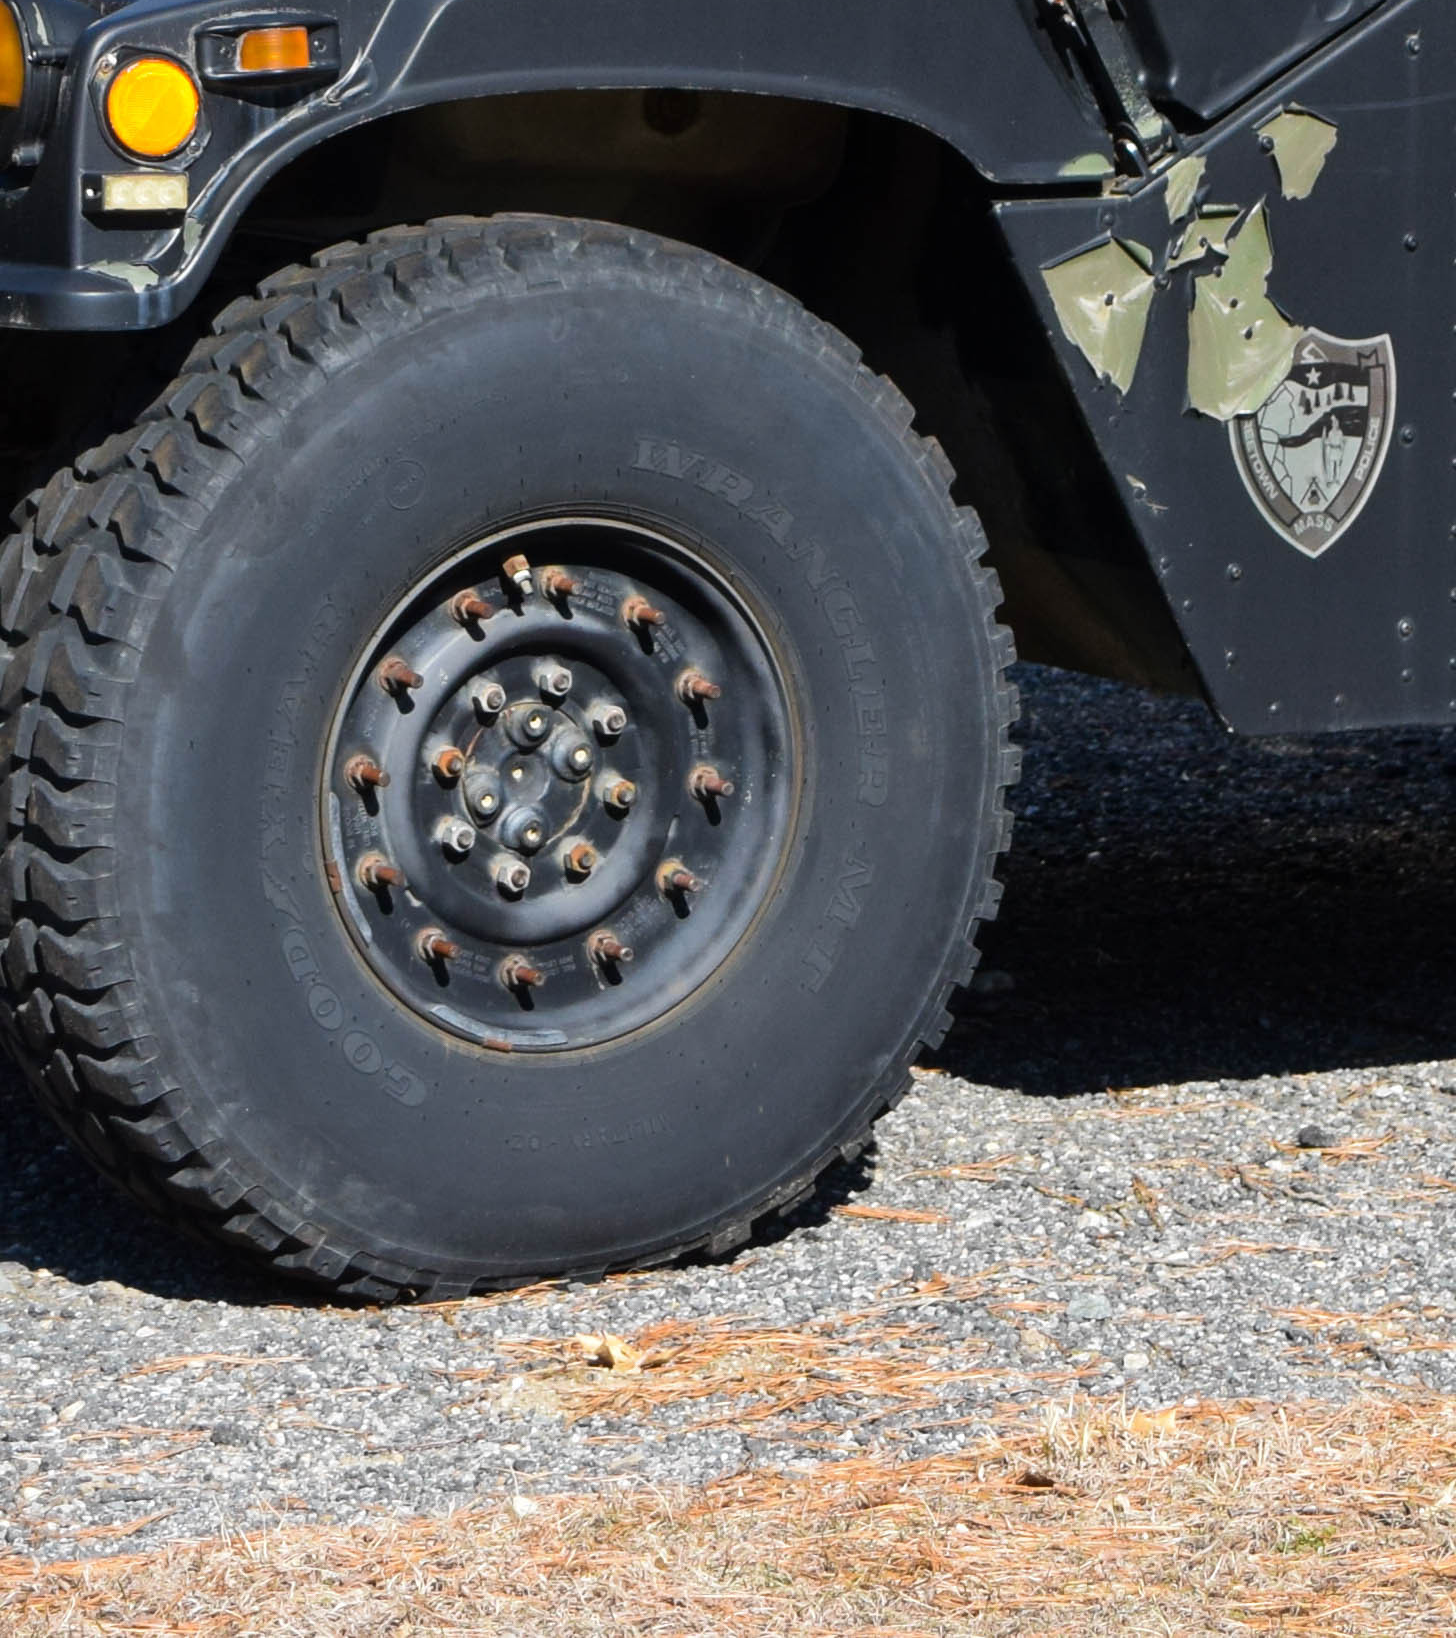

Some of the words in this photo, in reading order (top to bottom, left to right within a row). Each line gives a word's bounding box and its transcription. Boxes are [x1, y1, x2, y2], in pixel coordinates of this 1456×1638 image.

[1353, 416, 1382, 481] POLICE
[1293, 514, 1335, 536] MASS
[631, 435, 888, 808] WRANGLER
